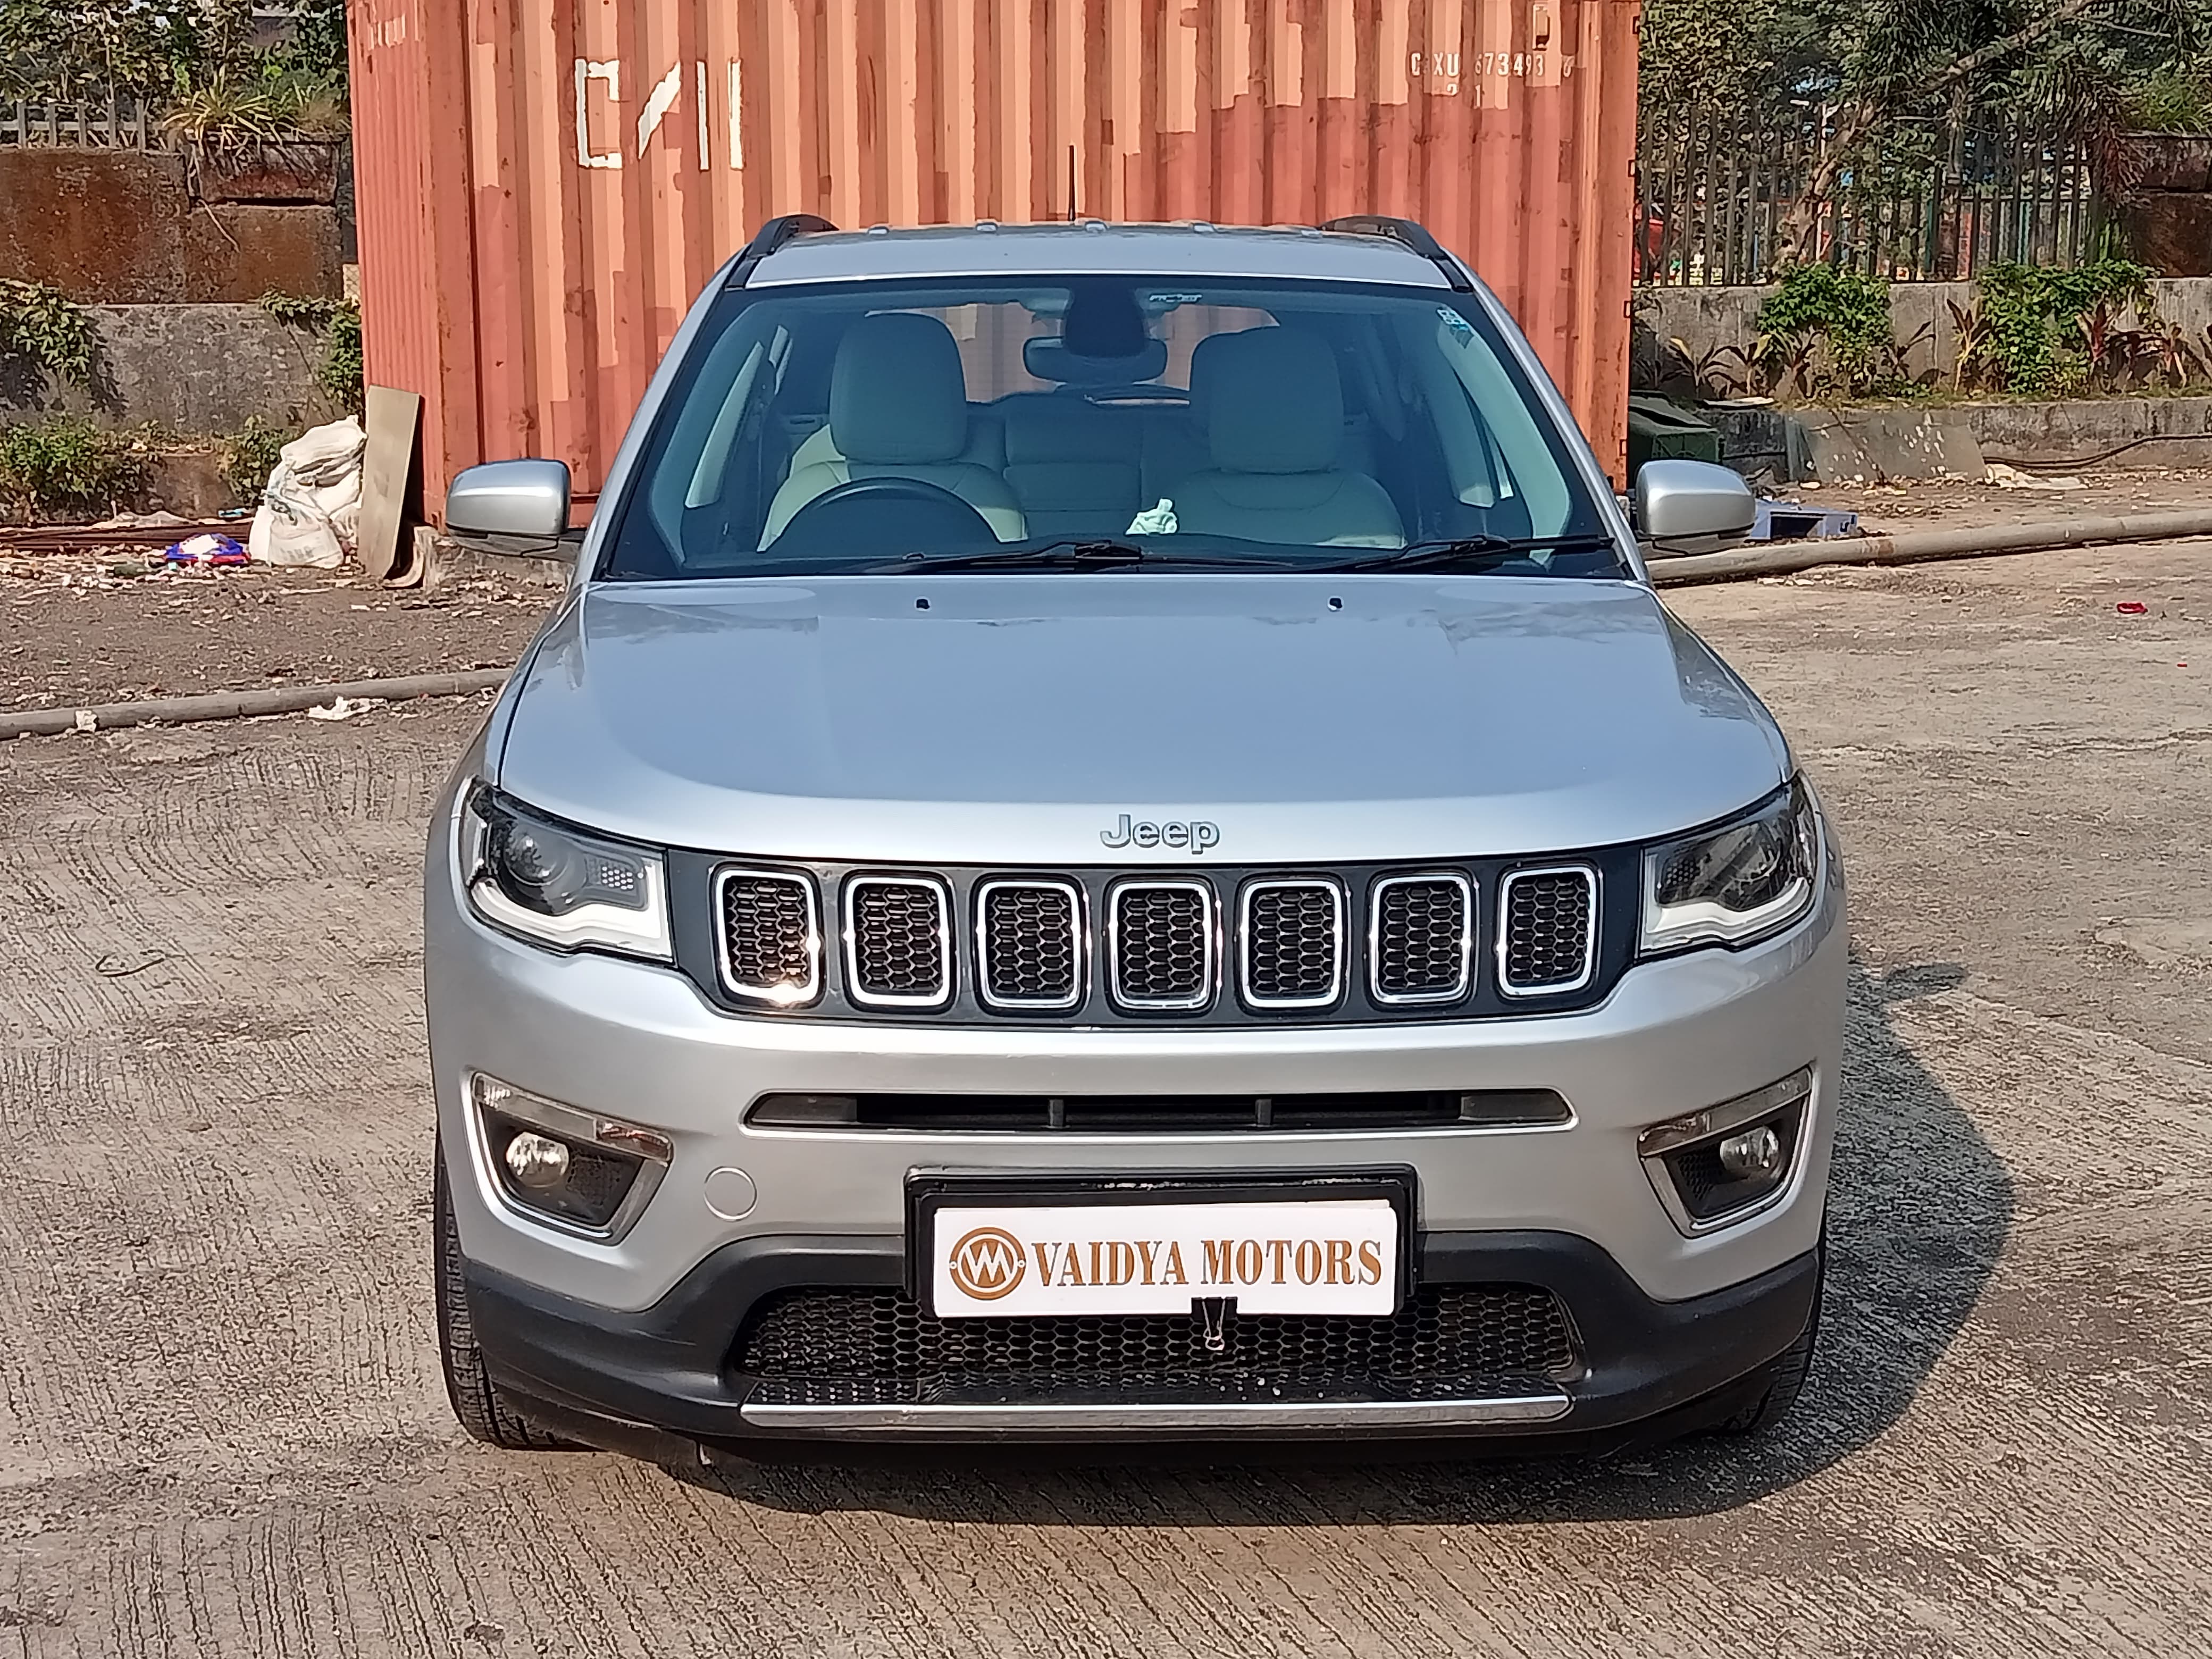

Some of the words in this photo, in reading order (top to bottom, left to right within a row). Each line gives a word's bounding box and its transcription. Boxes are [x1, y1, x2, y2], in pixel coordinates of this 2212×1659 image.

[1411, 52, 1460, 77] CXU
[1100, 814, 1220, 855] Jeep
[1030, 1241, 1189, 1287] VAIDYA
[1200, 1239, 1381, 1285] MOTORS
